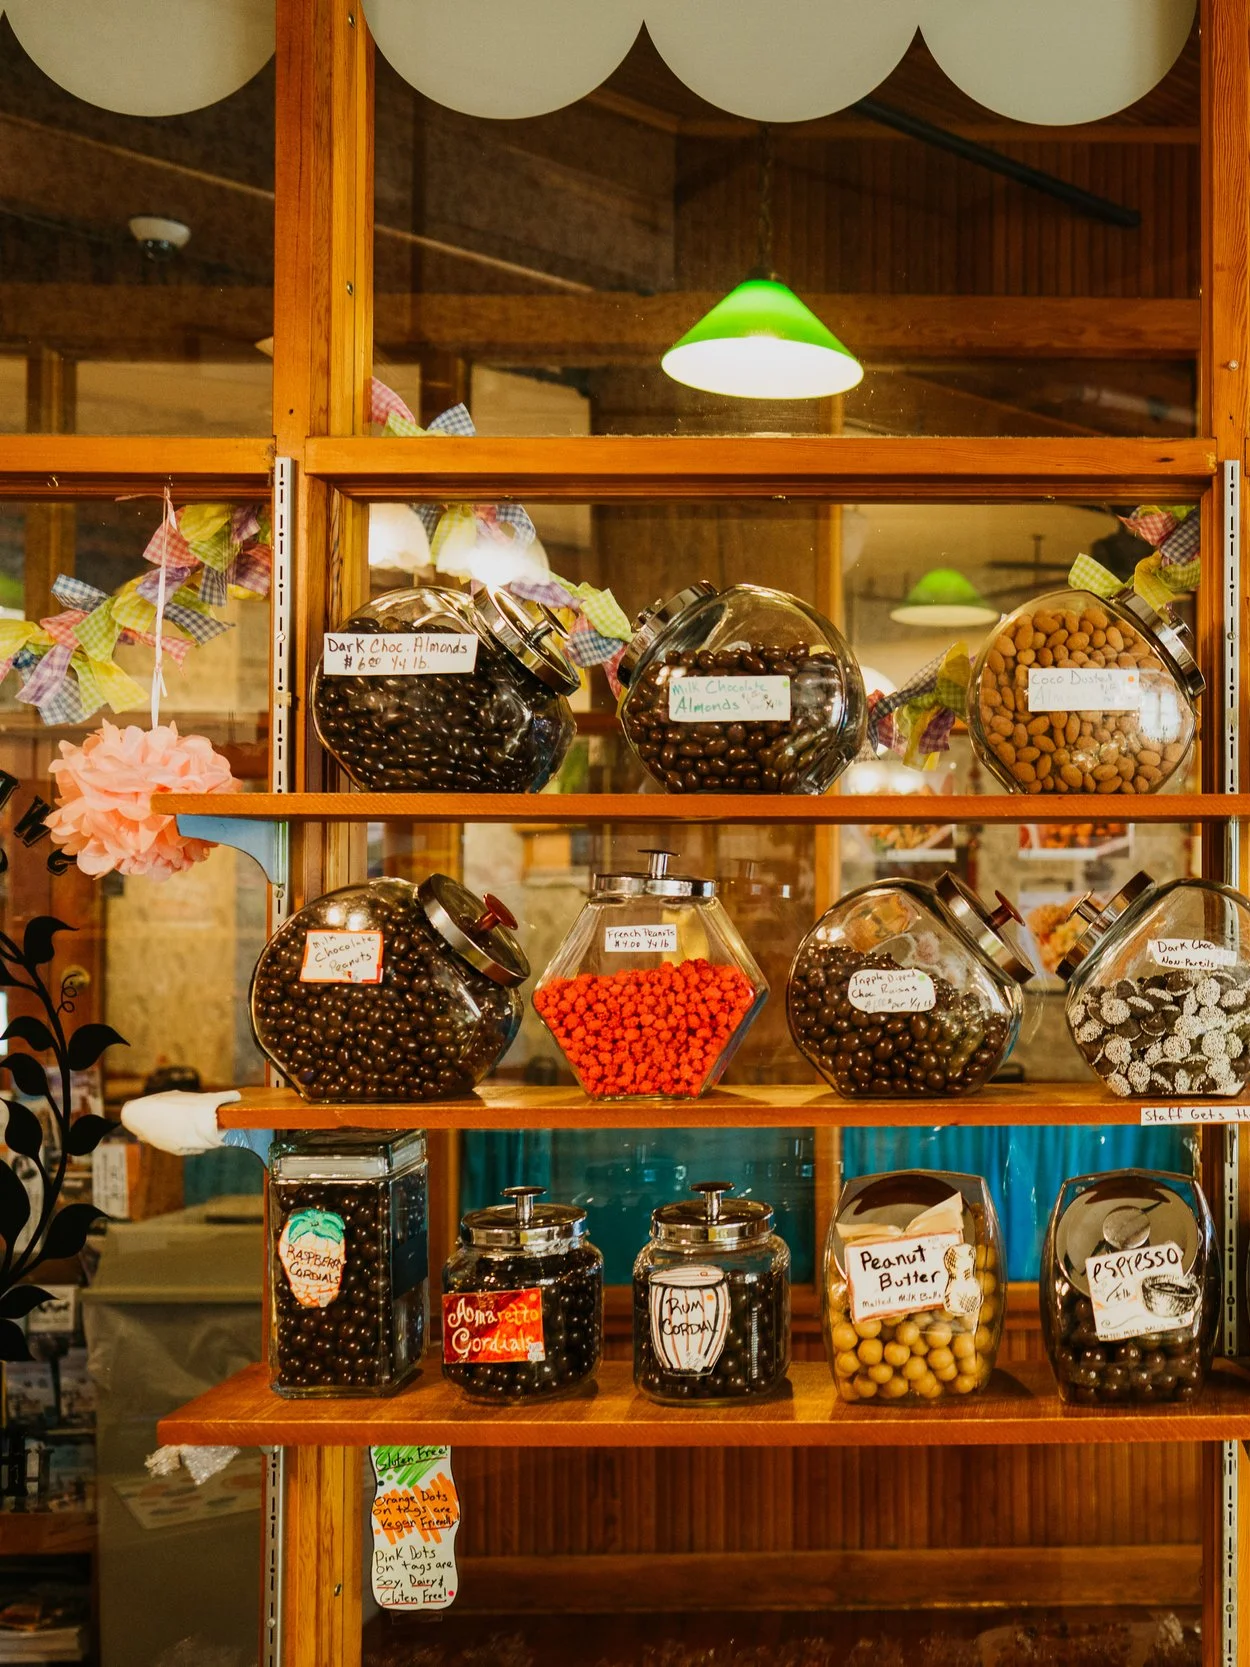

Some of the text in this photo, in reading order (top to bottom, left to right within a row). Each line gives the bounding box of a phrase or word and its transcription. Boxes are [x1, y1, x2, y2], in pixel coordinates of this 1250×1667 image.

[328, 637, 365, 653] Dark
[413, 636, 468, 654] Almonds
[672, 679, 768, 695] Milk Chocolate
[1031, 671, 1065, 686] Coco
[674, 696, 740, 715] Almonds
[312, 935, 337, 949] Milk
[607, 929, 642, 939] French
[314, 936, 376, 963] Chocolate
[1157, 939, 1215, 954] Dark Choc
[329, 952, 372, 976] Peanuts
[1144, 1108, 1183, 1122] Staff
[1190, 1108, 1225, 1120] Gets
[860, 1244, 927, 1271] Peanut
[289, 1261, 341, 1284] CORDIALS
[878, 1270, 941, 1291] Butter
[665, 1297, 705, 1315] RUM
[898, 1292, 916, 1303] Milk
[447, 1297, 539, 1328] Amaretto
[375, 1451, 414, 1471] Gluten
[374, 1490, 448, 1510] Orange Dots
[373, 1508, 392, 1516] on
[397, 1505, 427, 1517] tags
[381, 1518, 417, 1533] Vegan
[375, 1544, 436, 1566] Pink Dots
[376, 1560, 453, 1576] on tags are
[376, 1575, 403, 1589] Soy,
[409, 1573, 437, 1588] Dairy
[380, 1587, 447, 1606] Gluten Free!
